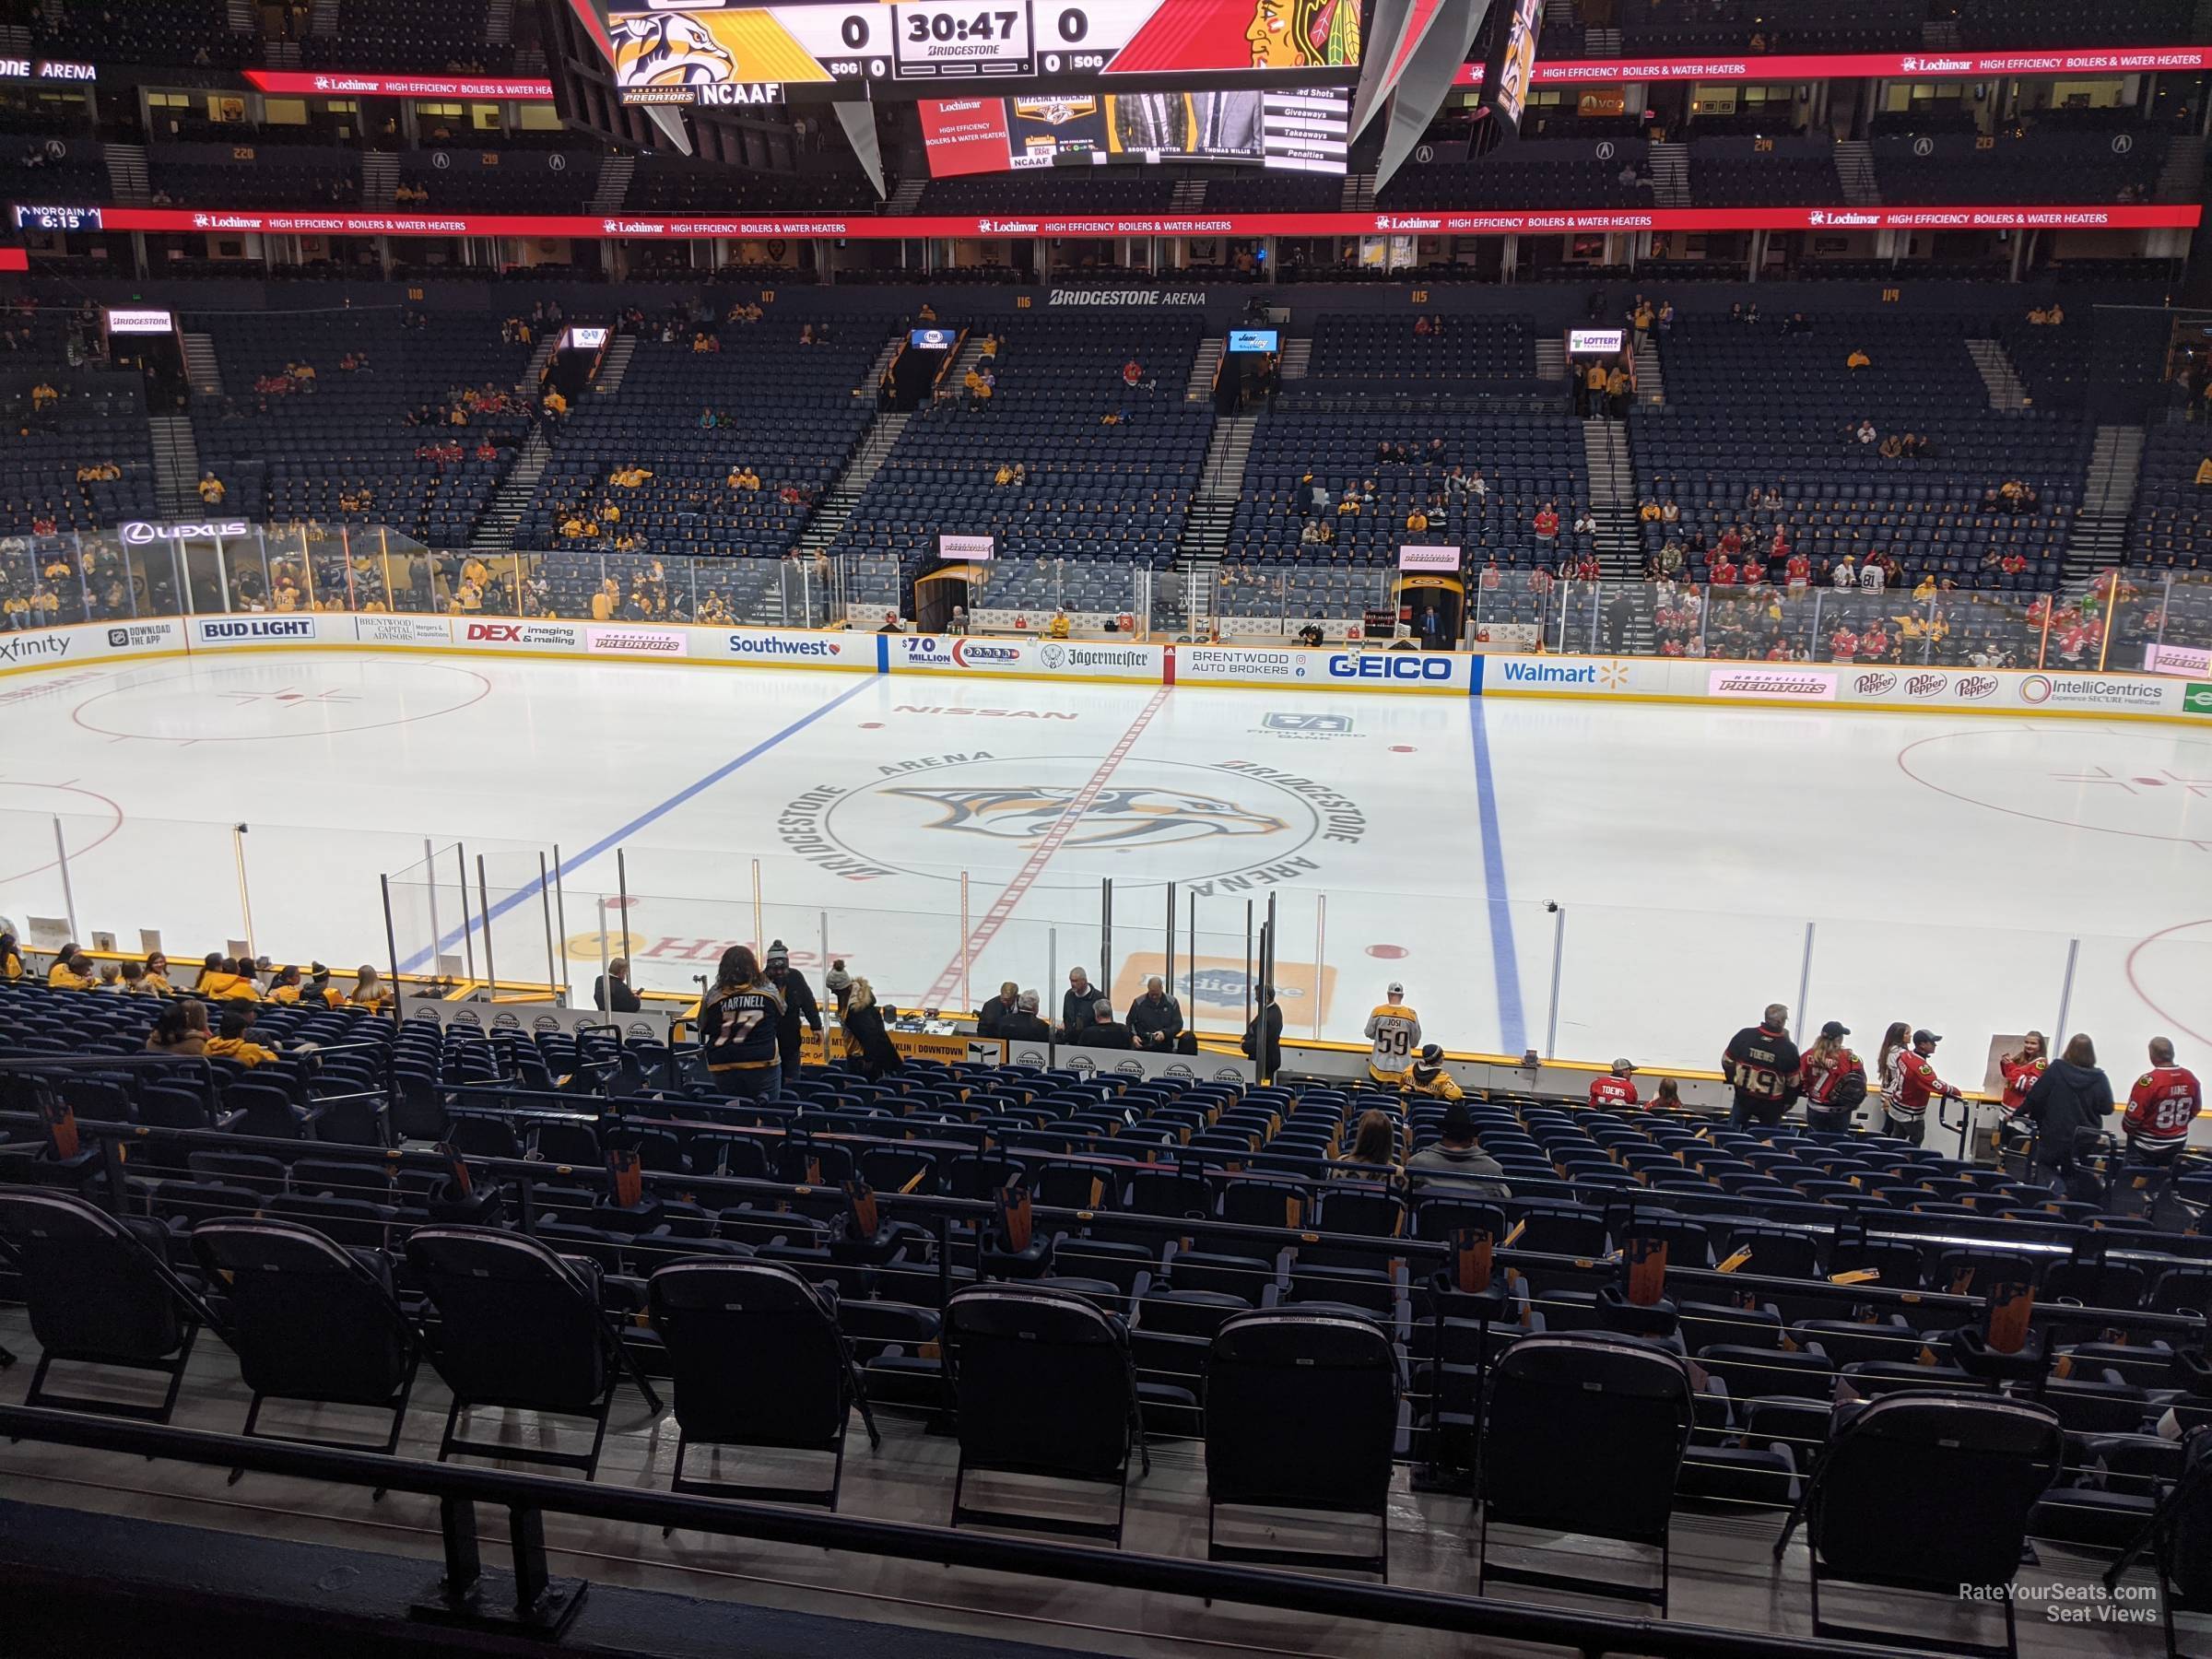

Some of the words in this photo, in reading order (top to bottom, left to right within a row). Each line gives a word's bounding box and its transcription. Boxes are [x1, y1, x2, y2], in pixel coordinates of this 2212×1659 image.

[907, 11, 1018, 42] 30:47
[1057, 7, 1088, 43] 0
[841, 15, 870, 50] 0
[927, 44, 1000, 56] BRIDGESTONE
[831, 62, 858, 76] SOG
[870, 59, 886, 77] 0
[1045, 54, 1061, 73] 0
[1074, 54, 1103, 69] SOG
[1917, 58, 1973, 72] Lochinvar
[1979, 59, 2006, 69] HIGH
[2006, 58, 2063, 69] EFFICIENCY
[2065, 56, 2108, 67] BOILERS
[2108, 56, 2118, 66] &
[2120, 55, 2155, 66] WATER
[2156, 54, 2202, 65] HEATERS
[41, 63, 97, 80] ARENA
[1542, 67, 1567, 78] HIGH
[1568, 66, 1619, 77] EFFICIENCY
[1622, 65, 1660, 76] BOILERS
[1661, 65, 1670, 76] &
[1671, 65, 1704, 76] WATER
[1705, 64, 1747, 75] HEATERS
[330, 78, 380, 91] Lochinvar
[385, 82, 408, 92] HIGH
[408, 82, 457, 93] EFFICIENCY
[460, 84, 496, 94] BOILERS
[496, 85, 505, 94] &
[504, 85, 535, 95] WATER
[1311, 88, 1335, 98] Shots
[623, 92, 695, 104] PREDATORS
[702, 84, 780, 104] NCAAF
[940, 100, 982, 112] Lochinvar
[1284, 108, 1327, 119] Giveaways
[957, 123, 991, 132] EFFICIENCY
[1284, 129, 1327, 139] Takeaways
[925, 137, 951, 146] BOILERS
[958, 135, 980, 143] WATER
[980, 131, 1006, 139] HEATERS
[1754, 139, 1772, 152] 214
[233, 147, 254, 159] 220
[1288, 149, 1324, 159] Penalties
[1014, 158, 1048, 166] NCAAF
[41, 216, 80, 229] 6:15
[210, 216, 263, 229] Lochinvar
[268, 218, 293, 229] HIGH
[294, 218, 344, 229] EFFICIENCY
[347, 219, 385, 229] BOILERS
[385, 220, 394, 229] &
[394, 220, 427, 230] WATER
[428, 221, 466, 231] HEATERS
[1391, 217, 1441, 229] Lochinvar
[1448, 218, 1472, 229] HIGH
[1473, 218, 1524, 228] EFFICIENCY
[1527, 217, 1566, 228] BOILERS
[1567, 217, 1575, 227] &
[1577, 217, 1609, 227] WATER
[1611, 216, 1652, 226] HEATERS
[1826, 212, 1881, 225] Lochinvar
[1887, 214, 1913, 224] HIGH
[1914, 214, 1971, 224] EFFICIENCY
[1973, 214, 2015, 224] BOILERS
[2016, 213, 2025, 224] &
[2027, 214, 2063, 224] WATER
[2064, 213, 2108, 224] HEATERS
[618, 221, 665, 233] Lochinvar
[670, 224, 692, 233] HIGH
[693, 224, 737, 233] EFFICIENCY
[740, 224, 773, 233] BOILERS
[773, 223, 782, 233] &
[782, 223, 810, 233] WATER
[811, 223, 846, 233] HEATERS
[993, 220, 1040, 232] Lochinvar
[1045, 222, 1066, 232] HIGH
[1068, 222, 1115, 231] EFFICIENCY
[1118, 221, 1153, 231] BOILERS
[1154, 221, 1162, 231] &
[1163, 221, 1194, 231] WATER
[1194, 220, 1232, 231] HEATERS
[761, 290, 775, 303] 117
[1017, 296, 1031, 309] 116
[1049, 289, 1159, 305] BRIDGESTONE
[1162, 292, 1206, 305] ARENA
[1412, 290, 1428, 303] 115
[1583, 336, 1618, 345] LOTTERY
[157, 523, 247, 538] LEXUS
[1863, 573, 1875, 587] 81
[205, 621, 248, 638] BUD
[252, 620, 310, 636] LIGHT
[359, 618, 412, 627] BRENTWOOD
[415, 624, 436, 632] Mergers
[129, 624, 171, 636] DOWNLOAD
[372, 632, 413, 641] ADVISORS
[467, 624, 523, 642] DEX
[527, 627, 574, 636] imaging
[131, 636, 145, 646] THE
[146, 634, 161, 644] APP
[523, 635, 532, 643] &
[534, 635, 575, 645] mailing
[595, 638, 679, 651] PREDATORS
[730, 635, 828, 656] Southwest
[0, 635, 70, 662] xfinity
[909, 653, 951, 663] MILLION
[1193, 651, 1288, 664] BRENTWOOD
[1192, 663, 1225, 672] AUTO
[1229, 664, 1288, 675] BROKERS
[1329, 655, 1453, 679] GEICO
[1504, 663, 1595, 683] Walmart
[1859, 675, 1893, 693] Pepper
[1870, 673, 1885, 682] Dr
[1920, 674, 1935, 683] Dr
[1971, 676, 1986, 685] Dr
[1719, 680, 1827, 694] PREDATORS
[1909, 677, 1944, 695] Pepper
[1959, 678, 1994, 697] Pepper
[2053, 680, 2162, 698] IntelliCentrics
[2052, 694, 2088, 702] Experience
[893, 705, 1078, 720] NISSAN
[877, 751, 994, 775] ARENA
[1210, 759, 1366, 843] BRIDGESTONE
[777, 784, 900, 880] BRIDGESTONE
[1187, 856, 1321, 897] ARENA
[721, 995, 766, 1012] HARTNELL
[714, 1010, 765, 1046] 17
[1387, 1018, 1402, 1028] JOSI
[1378, 1028, 1408, 1056] 59
[918, 1044, 963, 1056] DOWNTOWN
[1748, 1047, 1776, 1063] TOEWS
[1735, 1065, 1785, 1094] 19
[1602, 1085, 1626, 1097] TOEWS
[2157, 1097, 2193, 1129] 88
